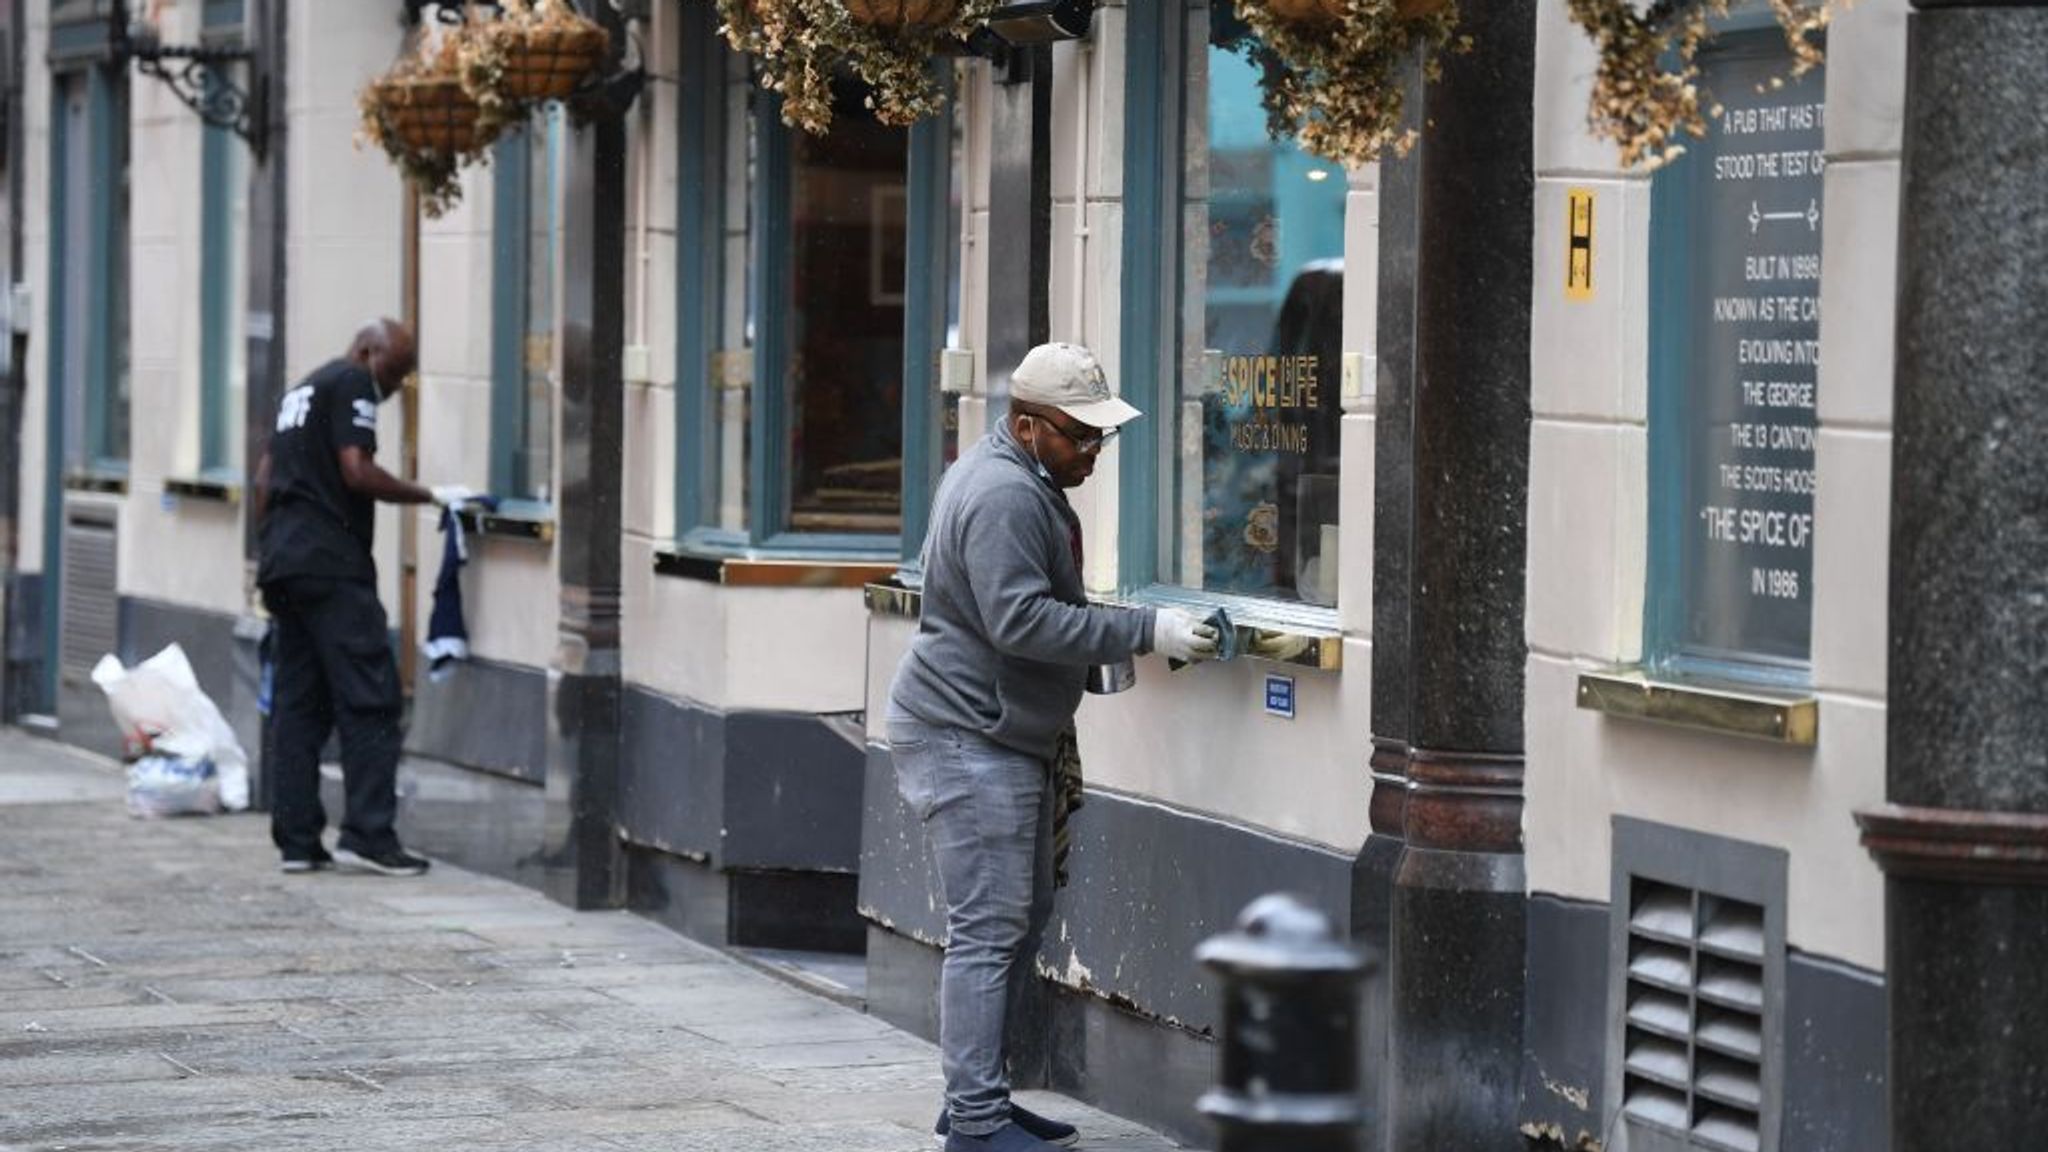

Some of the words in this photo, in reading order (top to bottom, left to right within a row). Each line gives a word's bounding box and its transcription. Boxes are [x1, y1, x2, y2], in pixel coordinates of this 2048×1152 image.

[1723, 111, 1731, 134] A
[1733, 109, 1757, 134] PUB
[1759, 105, 1787, 131] THAT
[1790, 103, 1813, 130] HAS
[1715, 154, 1754, 180] STOOD
[1756, 152, 1779, 178] THE
[1781, 150, 1809, 176] TEST
[1746, 256, 1776, 280] BUILT
[1778, 255, 1789, 280] IN
[1714, 297, 1757, 322] KNOWN
[1759, 296, 1775, 322] AS
[1776, 296, 1799, 322] THE
[1739, 339, 1793, 365] EVOLVING
[1229, 355, 1277, 408] SPICE
[1280, 355, 1318, 408] LIFE
[1742, 381, 1765, 407] THE
[1730, 423, 1752, 448] THE
[1754, 424, 1767, 449] 13
[1719, 464, 1741, 489] THE
[1744, 466, 1781, 493] SCOTS
[1740, 510, 1786, 546] SPICE
[1788, 513, 1811, 548] OF
[1752, 567, 1765, 595] IN
[1768, 569, 1799, 599] 1986
